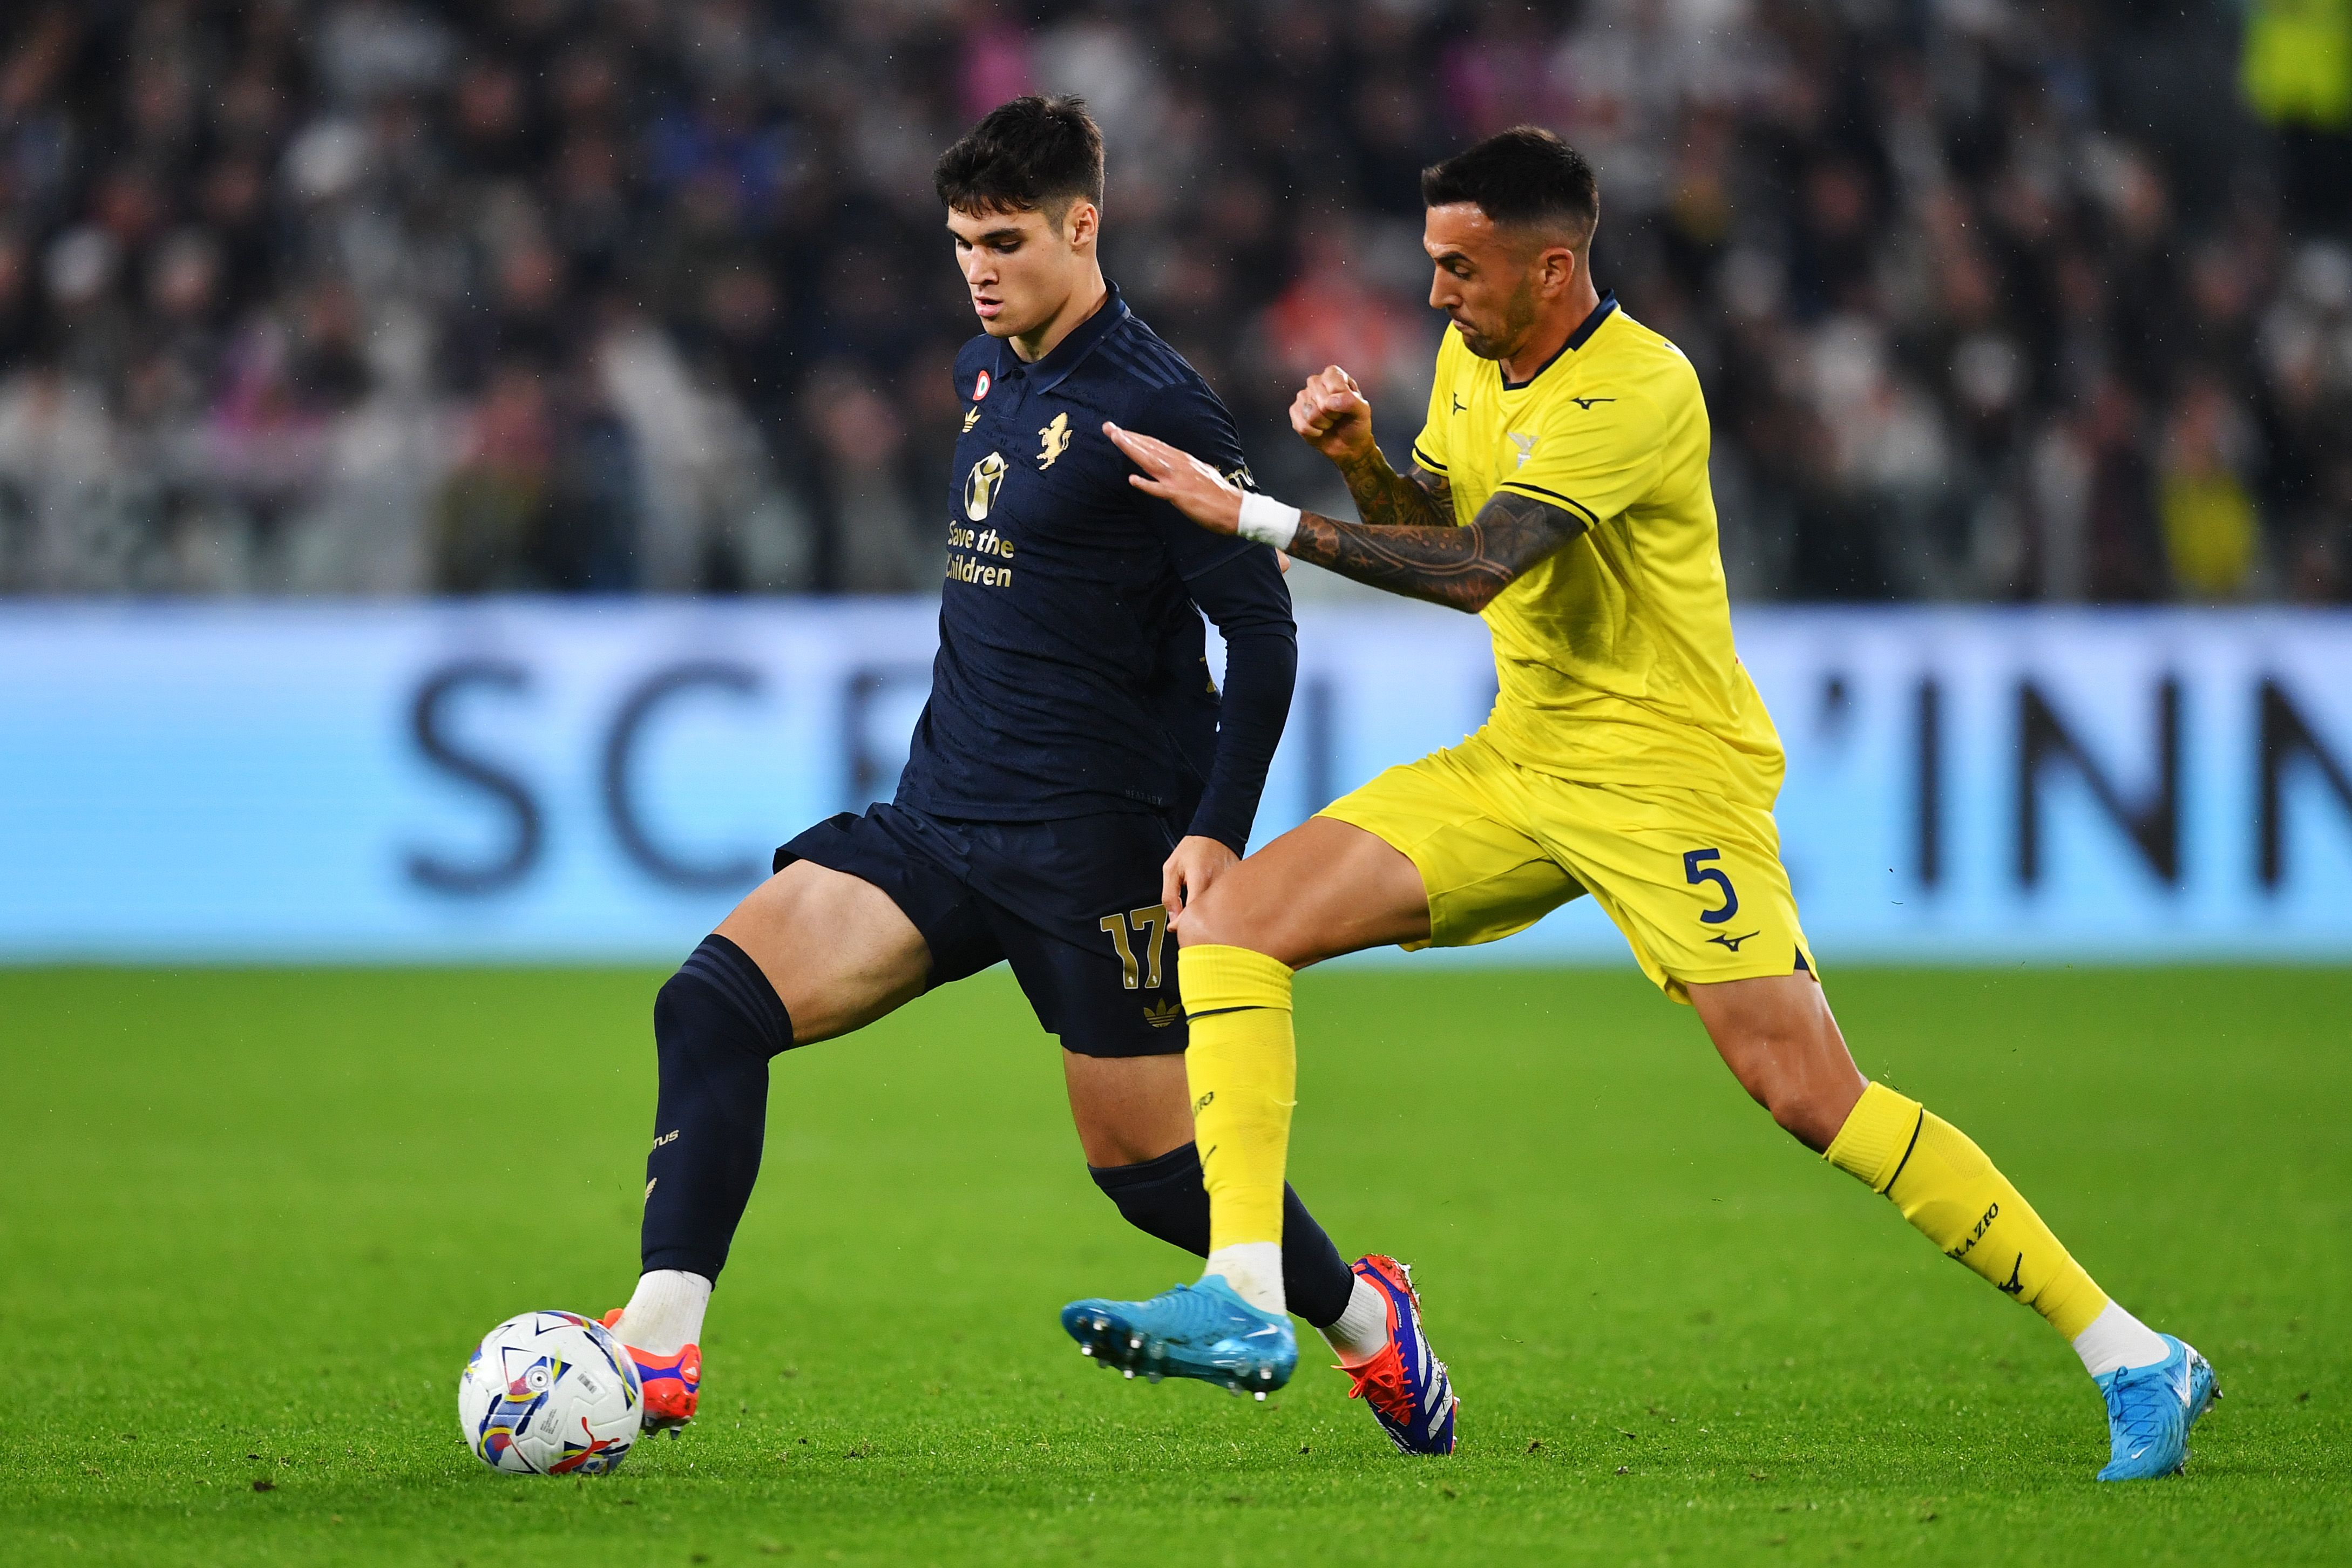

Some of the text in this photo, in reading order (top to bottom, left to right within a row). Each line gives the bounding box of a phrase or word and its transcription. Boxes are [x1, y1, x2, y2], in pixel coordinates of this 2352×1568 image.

[947, 520, 1015, 559] Save the
[1683, 847, 1738, 924] 5
[1100, 903, 1169, 989] 17
[1954, 1202, 1999, 1257] LAZIO
